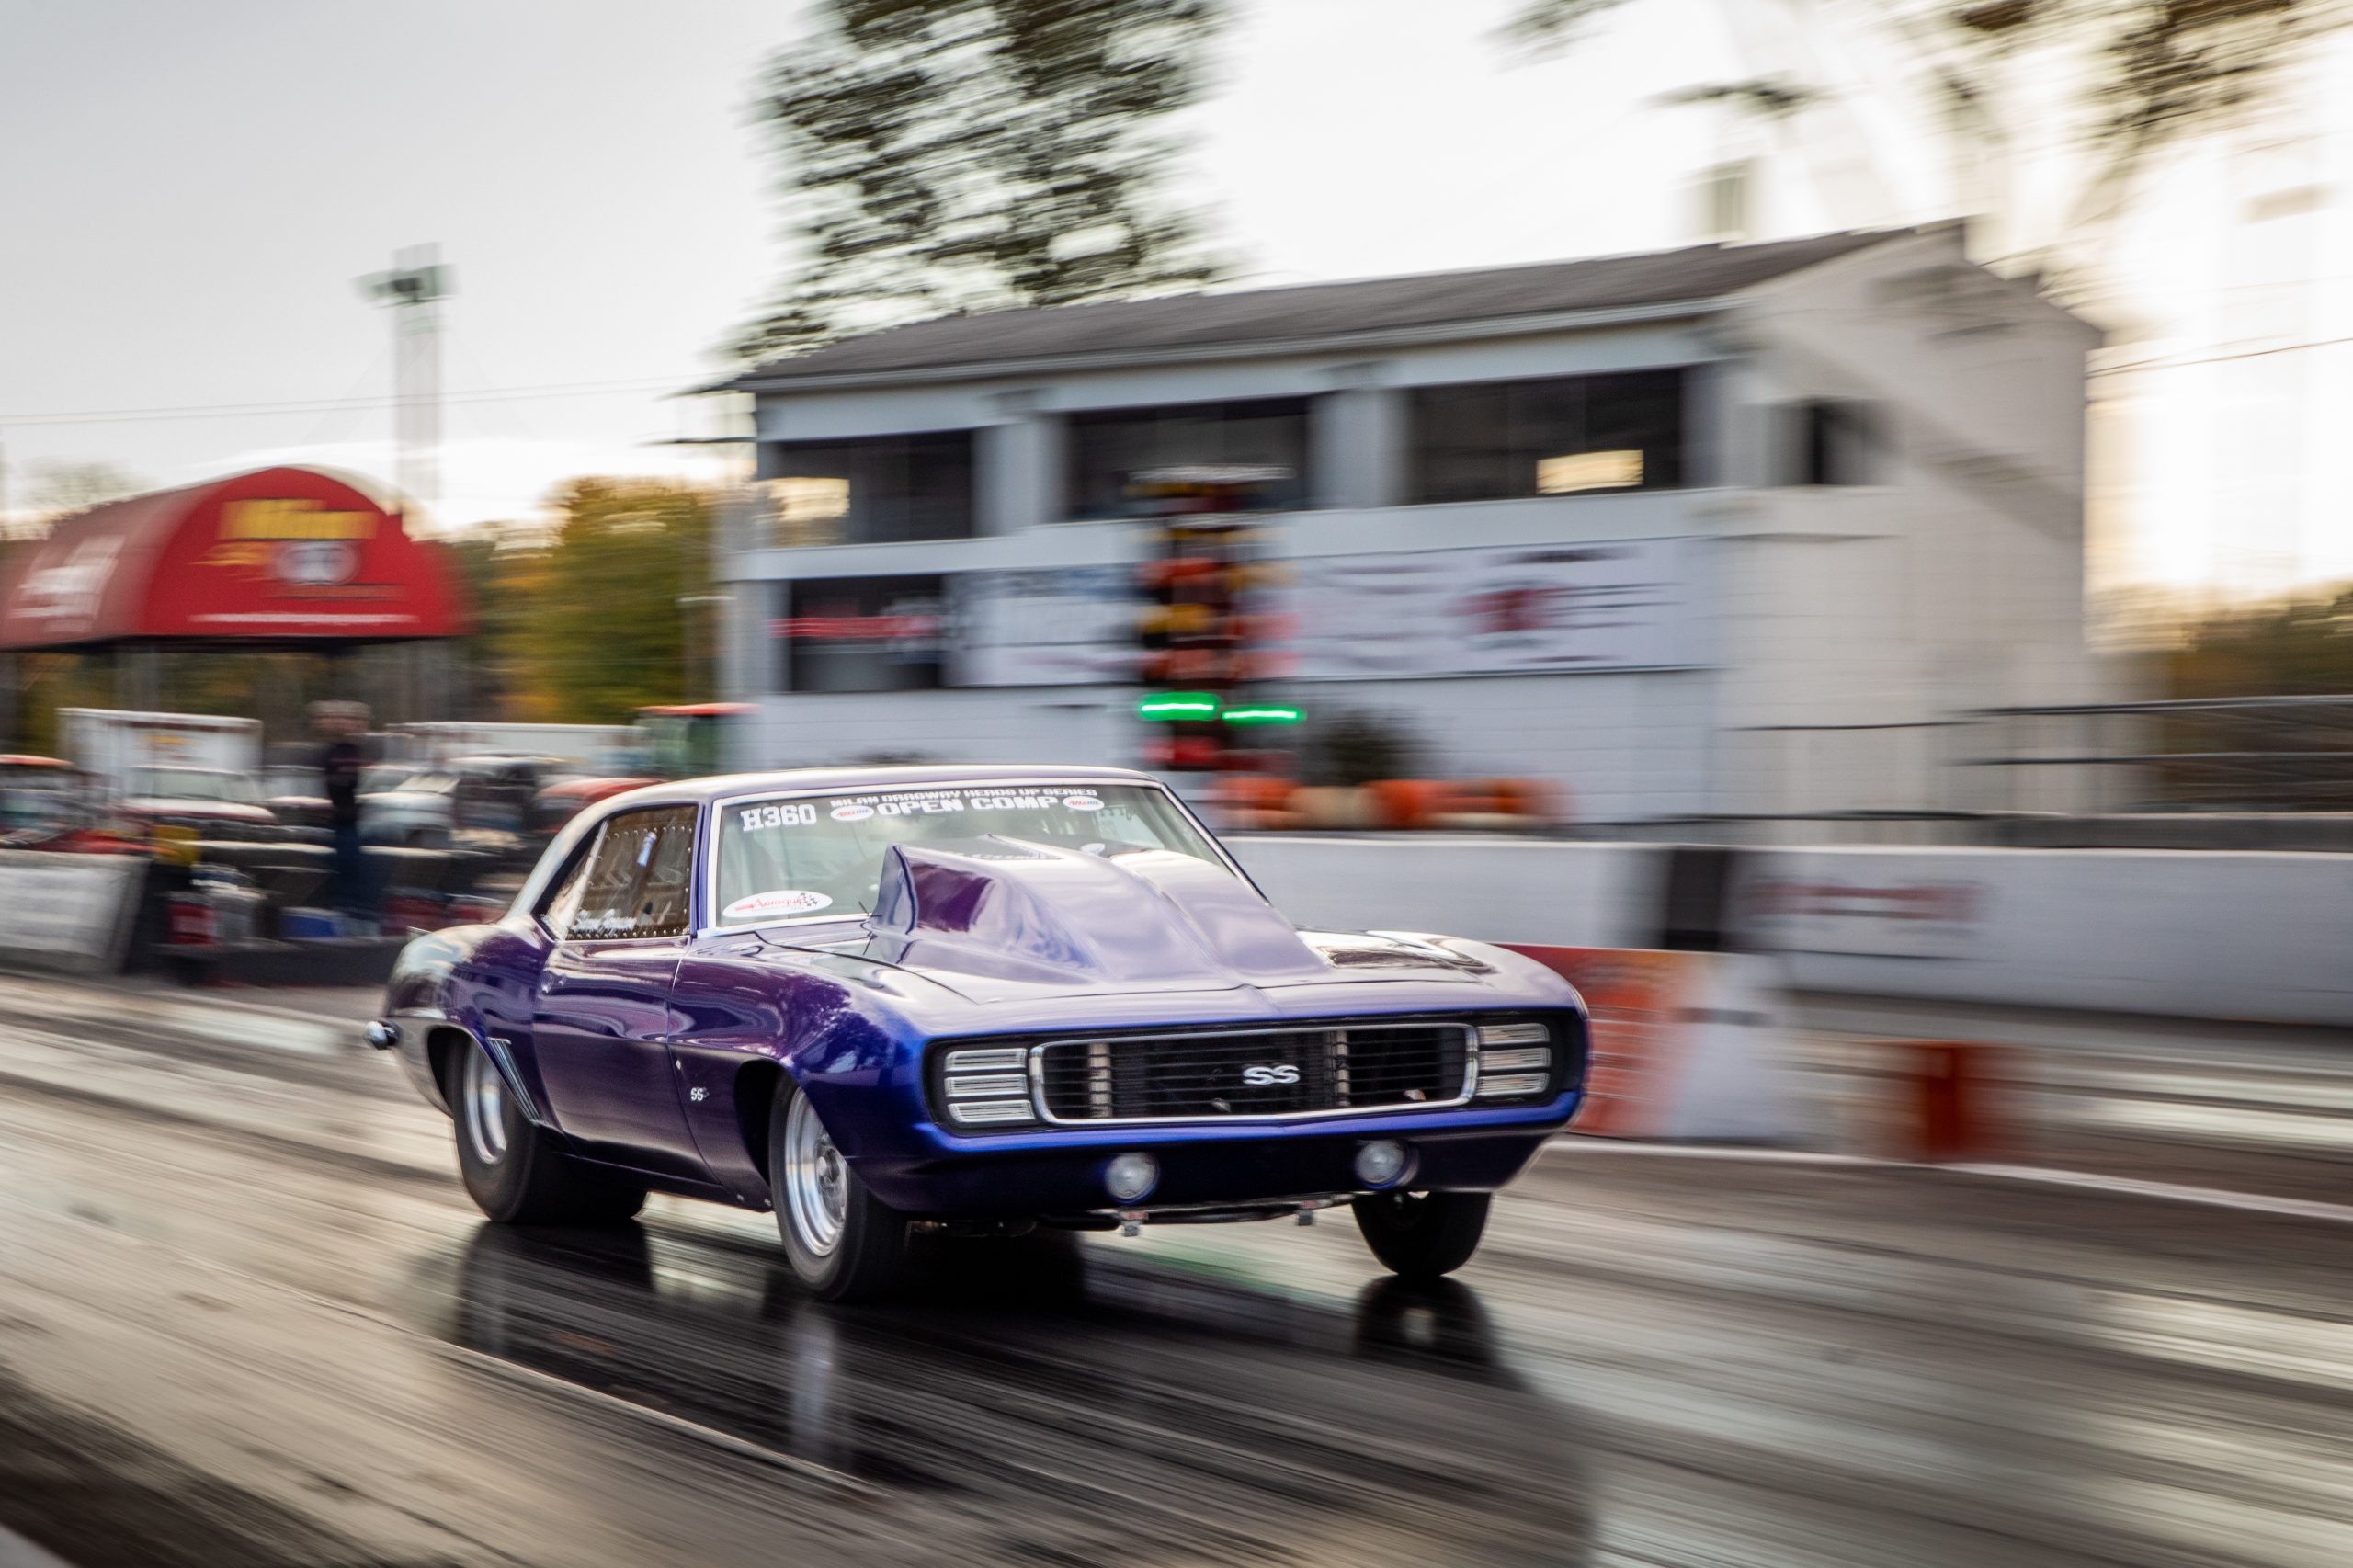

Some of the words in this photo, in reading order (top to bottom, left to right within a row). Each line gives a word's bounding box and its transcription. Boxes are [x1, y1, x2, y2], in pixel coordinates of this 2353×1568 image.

[830, 796, 879, 807] MILAN
[881, 790, 961, 802] DRAGWAY
[963, 789, 1017, 797] HEADS
[1018, 788, 1040, 796] UP
[1042, 788, 1097, 797] SERIES
[877, 799, 964, 815] OPEN
[971, 796, 1059, 809] COMP
[740, 803, 817, 832] H360
[1243, 1064, 1301, 1085] SS
[690, 1087, 704, 1101] SS
